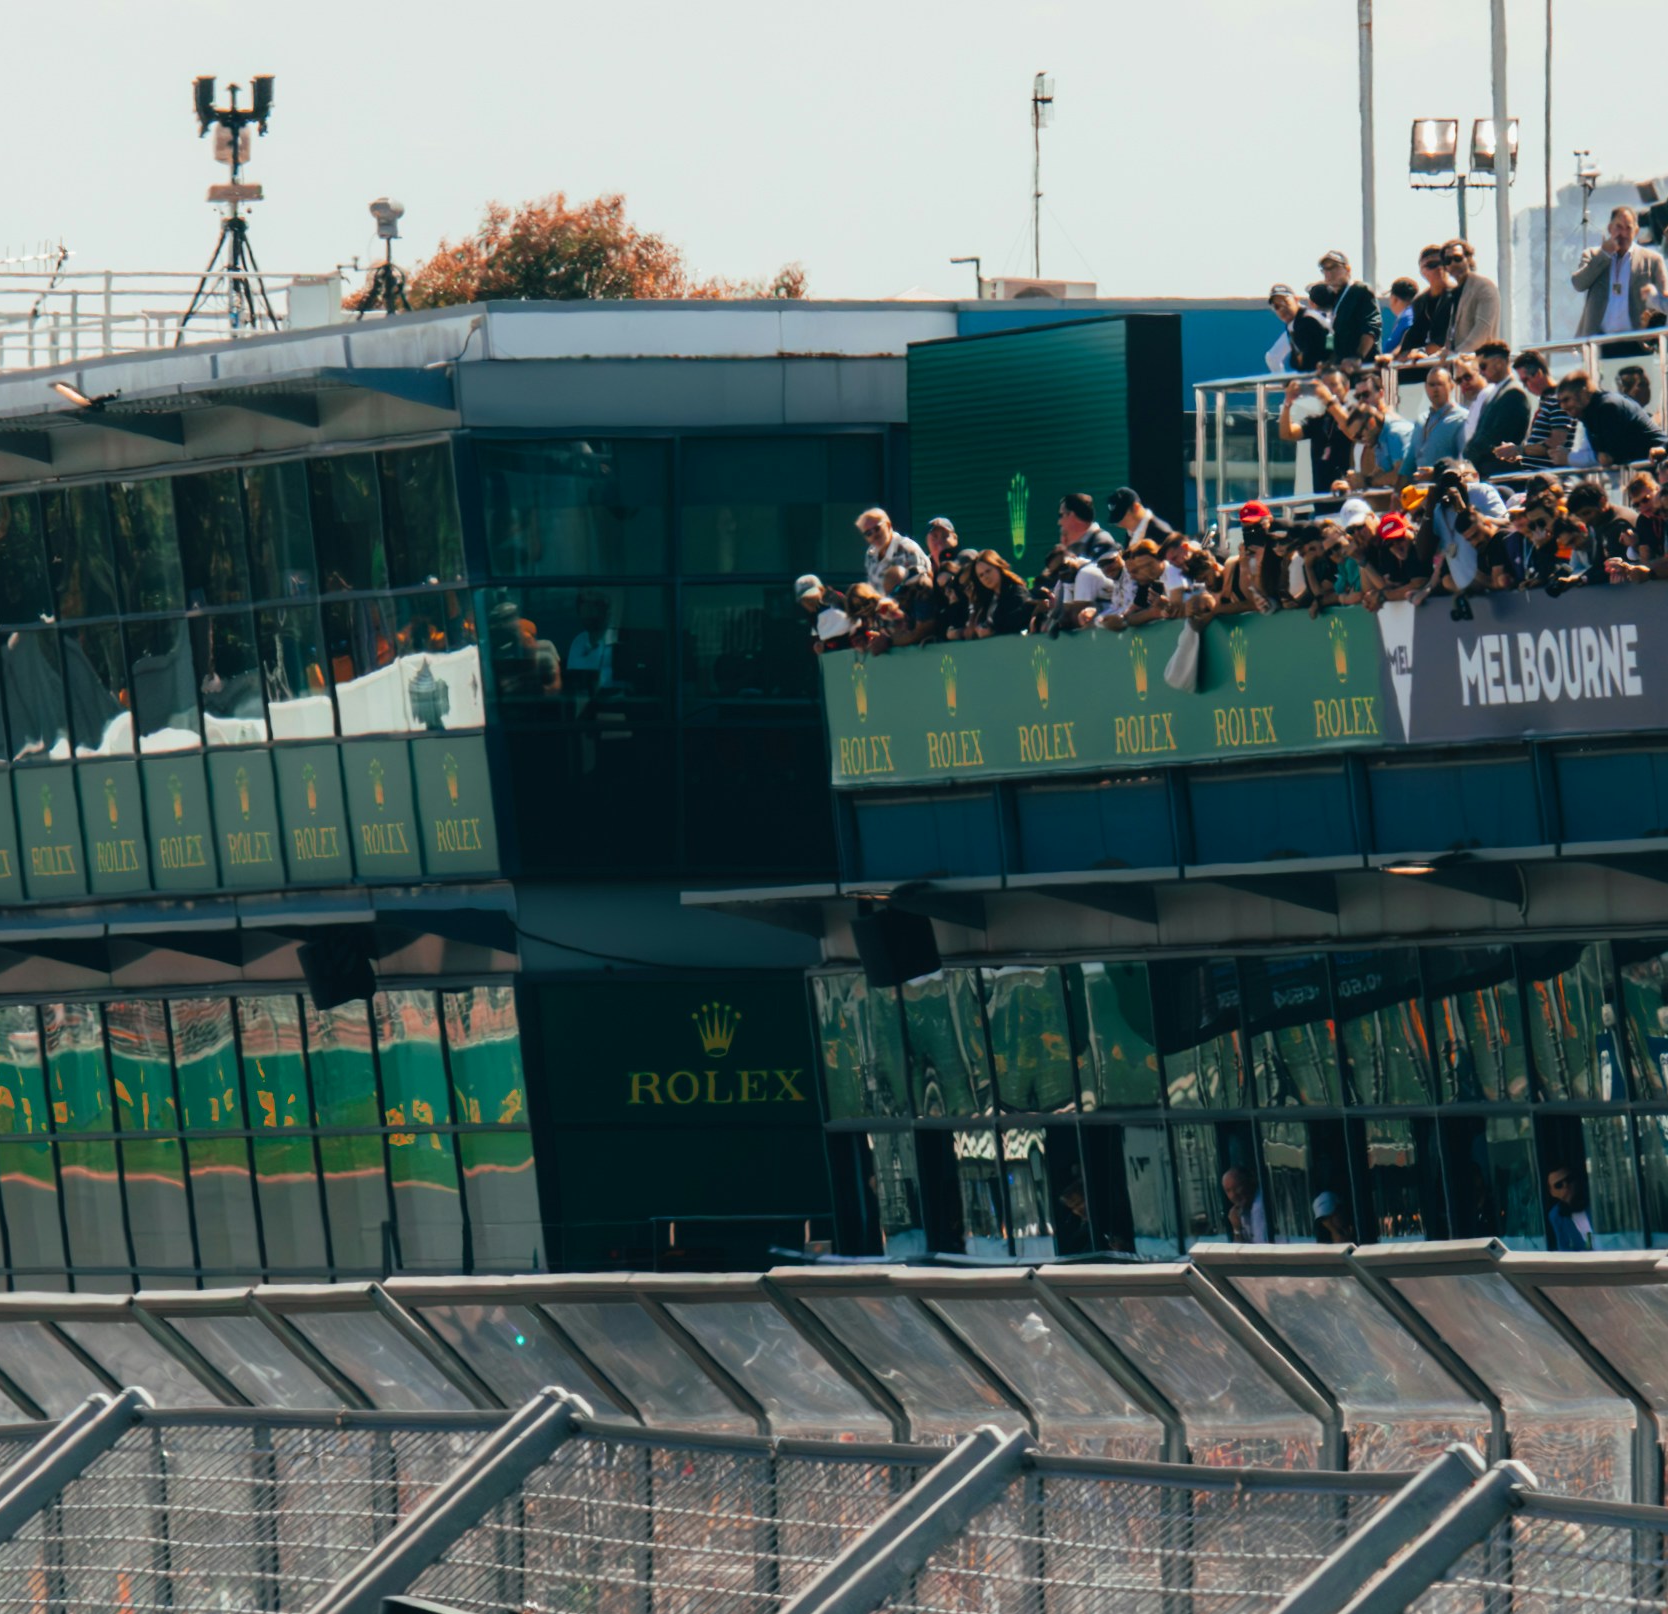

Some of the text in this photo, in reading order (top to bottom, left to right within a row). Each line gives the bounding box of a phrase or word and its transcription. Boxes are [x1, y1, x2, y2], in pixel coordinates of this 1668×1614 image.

[1385, 645, 1414, 675] MEL
[1456, 624, 1643, 706] MELBOURNE
[839, 696, 1379, 776] ROLEX ROLEX ROLEX ROLEX ROLEX ROLEX
[160, 835, 205, 871] ROLEX
[228, 831, 273, 866] ROLEX
[294, 826, 340, 862] ROLEX
[362, 822, 409, 857] ROLEX
[436, 818, 484, 853] ROLEX
[97, 839, 138, 874] ROLEX
[627, 1068, 806, 1106] ROLEX
